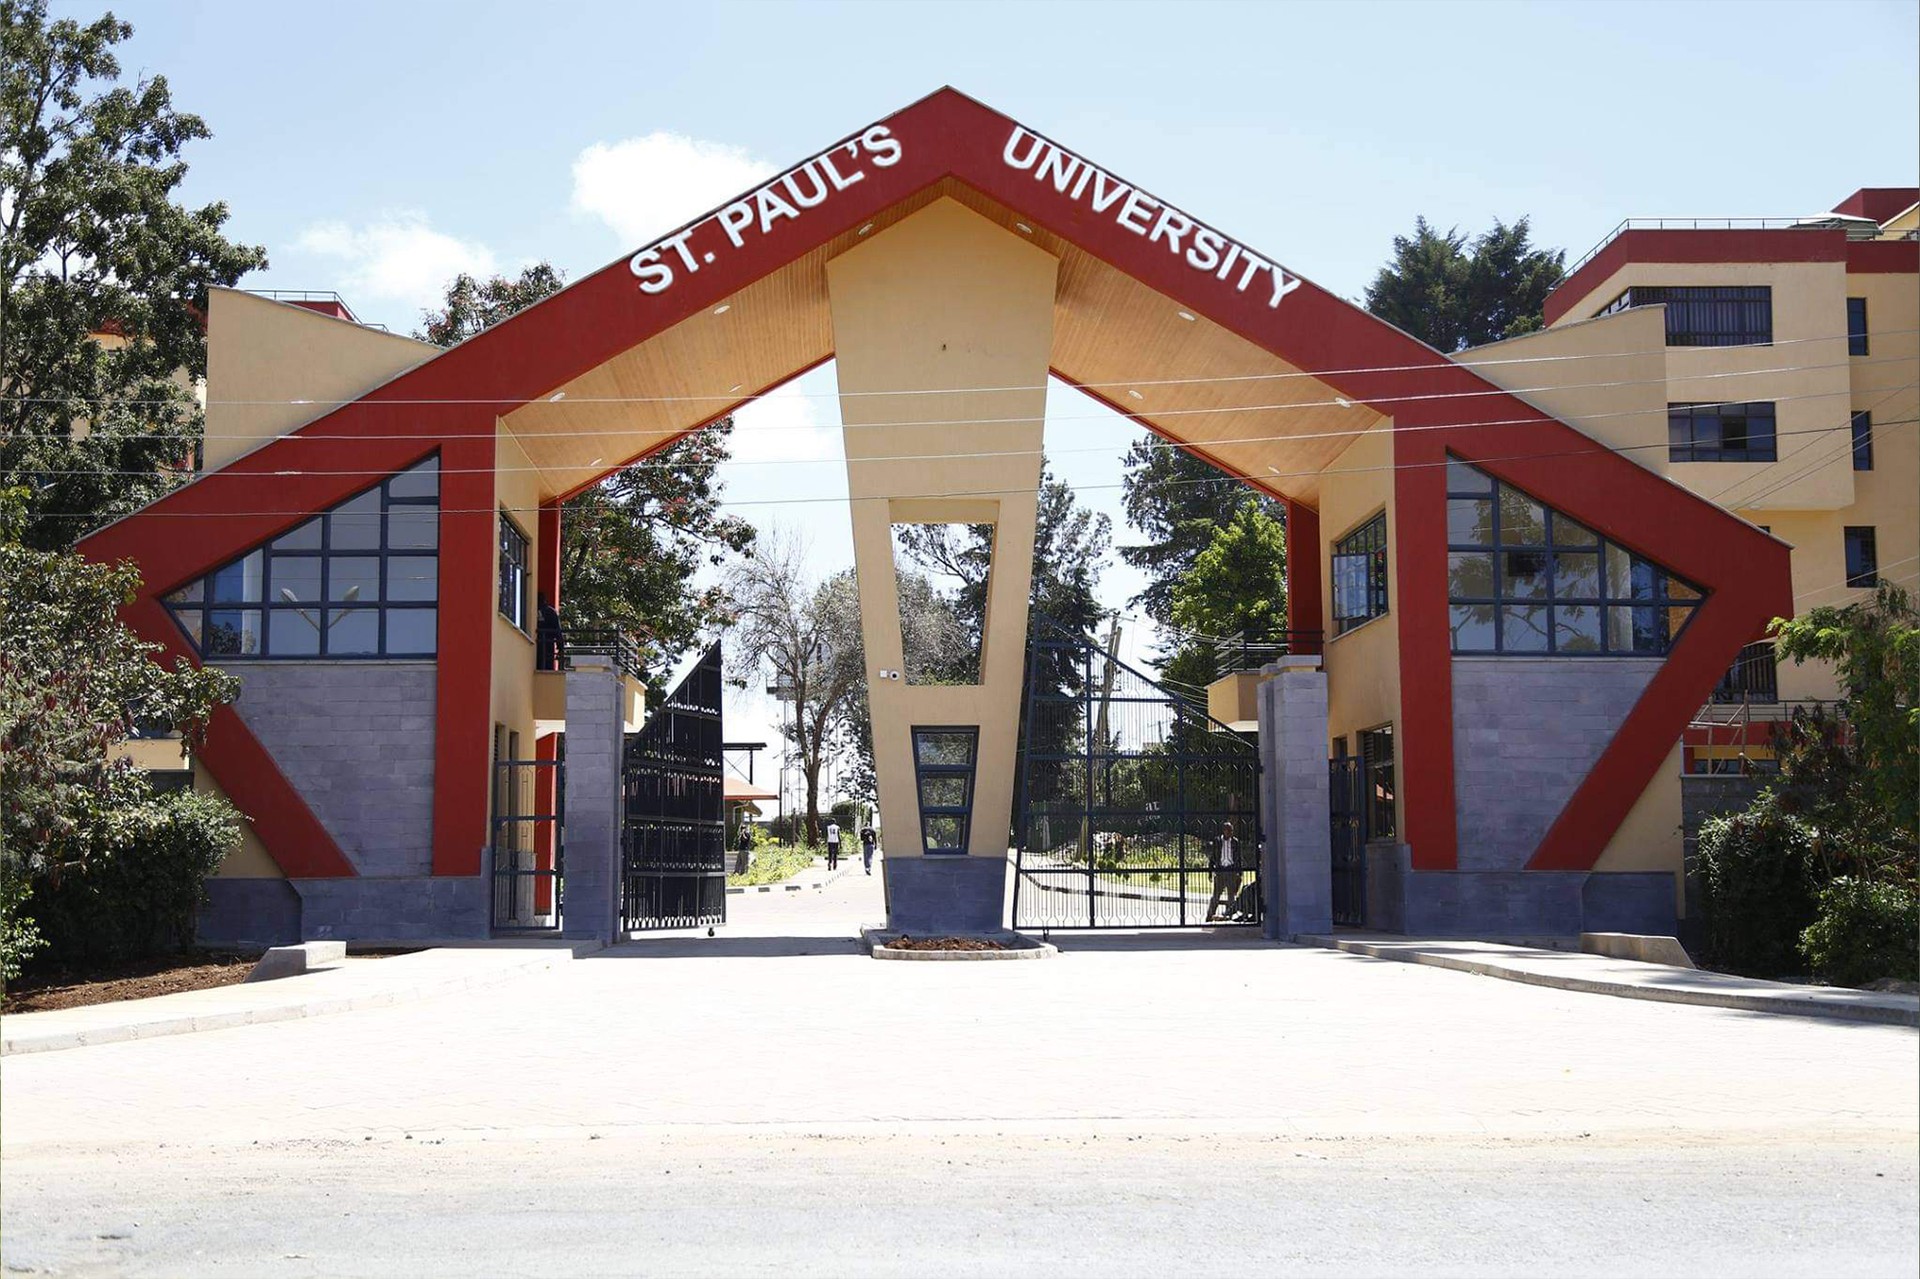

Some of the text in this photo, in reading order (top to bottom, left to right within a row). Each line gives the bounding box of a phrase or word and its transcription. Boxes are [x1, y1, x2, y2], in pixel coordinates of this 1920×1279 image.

[630, 125, 1302, 308] ST. PAUL'S UNIVERSITY
